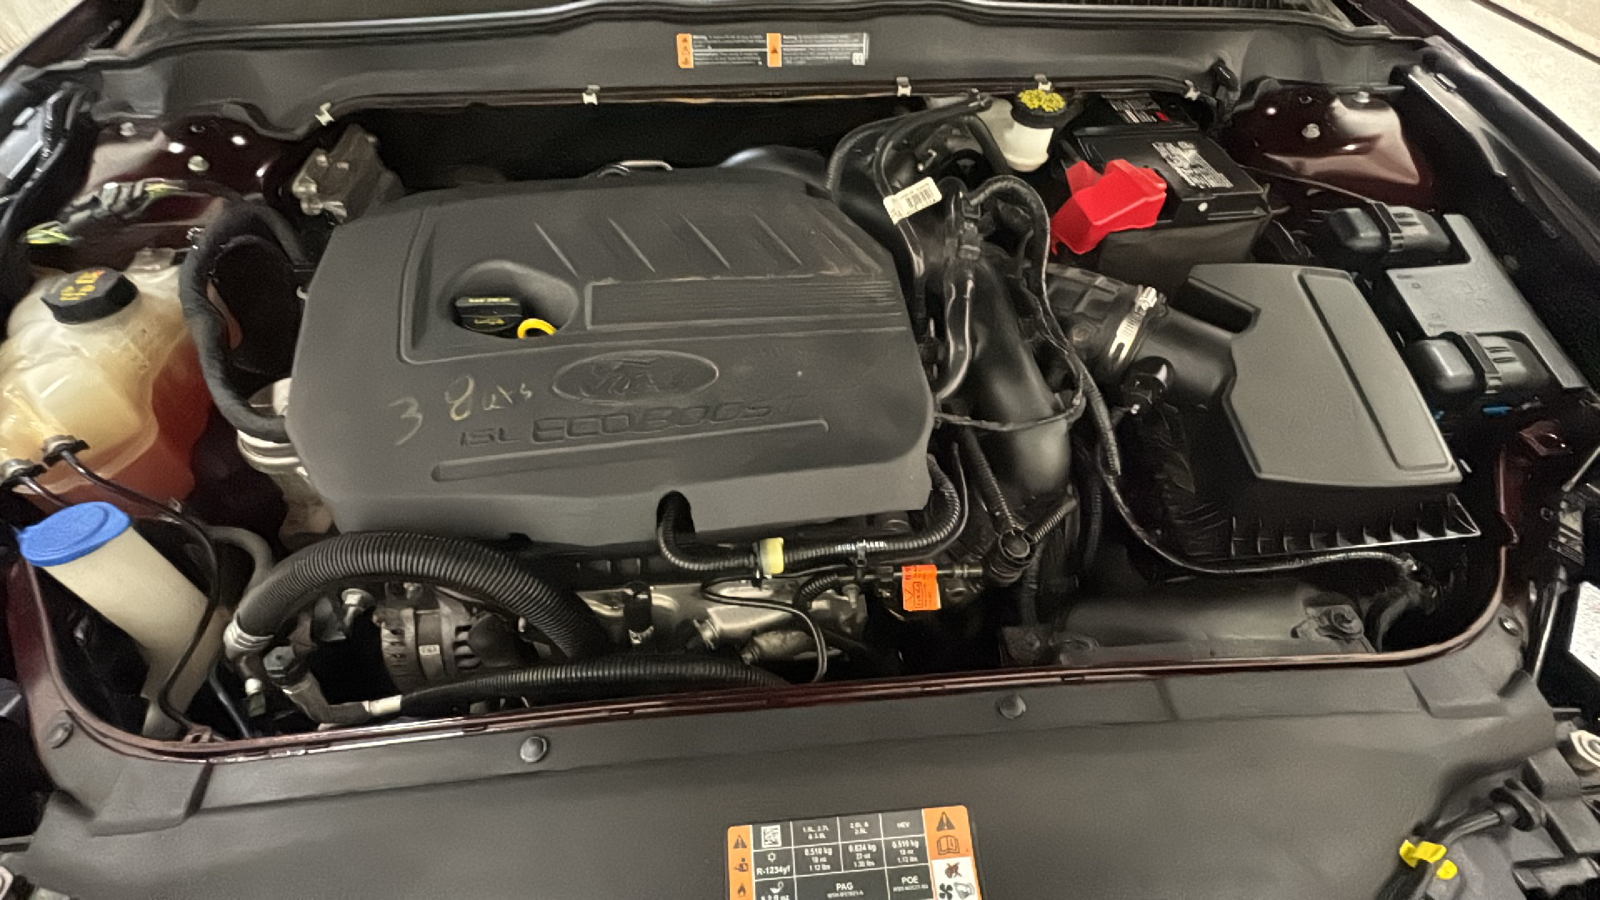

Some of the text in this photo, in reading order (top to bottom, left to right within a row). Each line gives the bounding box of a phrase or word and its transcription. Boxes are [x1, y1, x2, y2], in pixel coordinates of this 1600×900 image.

[388, 396, 423, 446] 3
[756, 865, 791, 876] R-1234yf
[901, 875, 919, 884] POE
[835, 882, 854, 891] PAG
